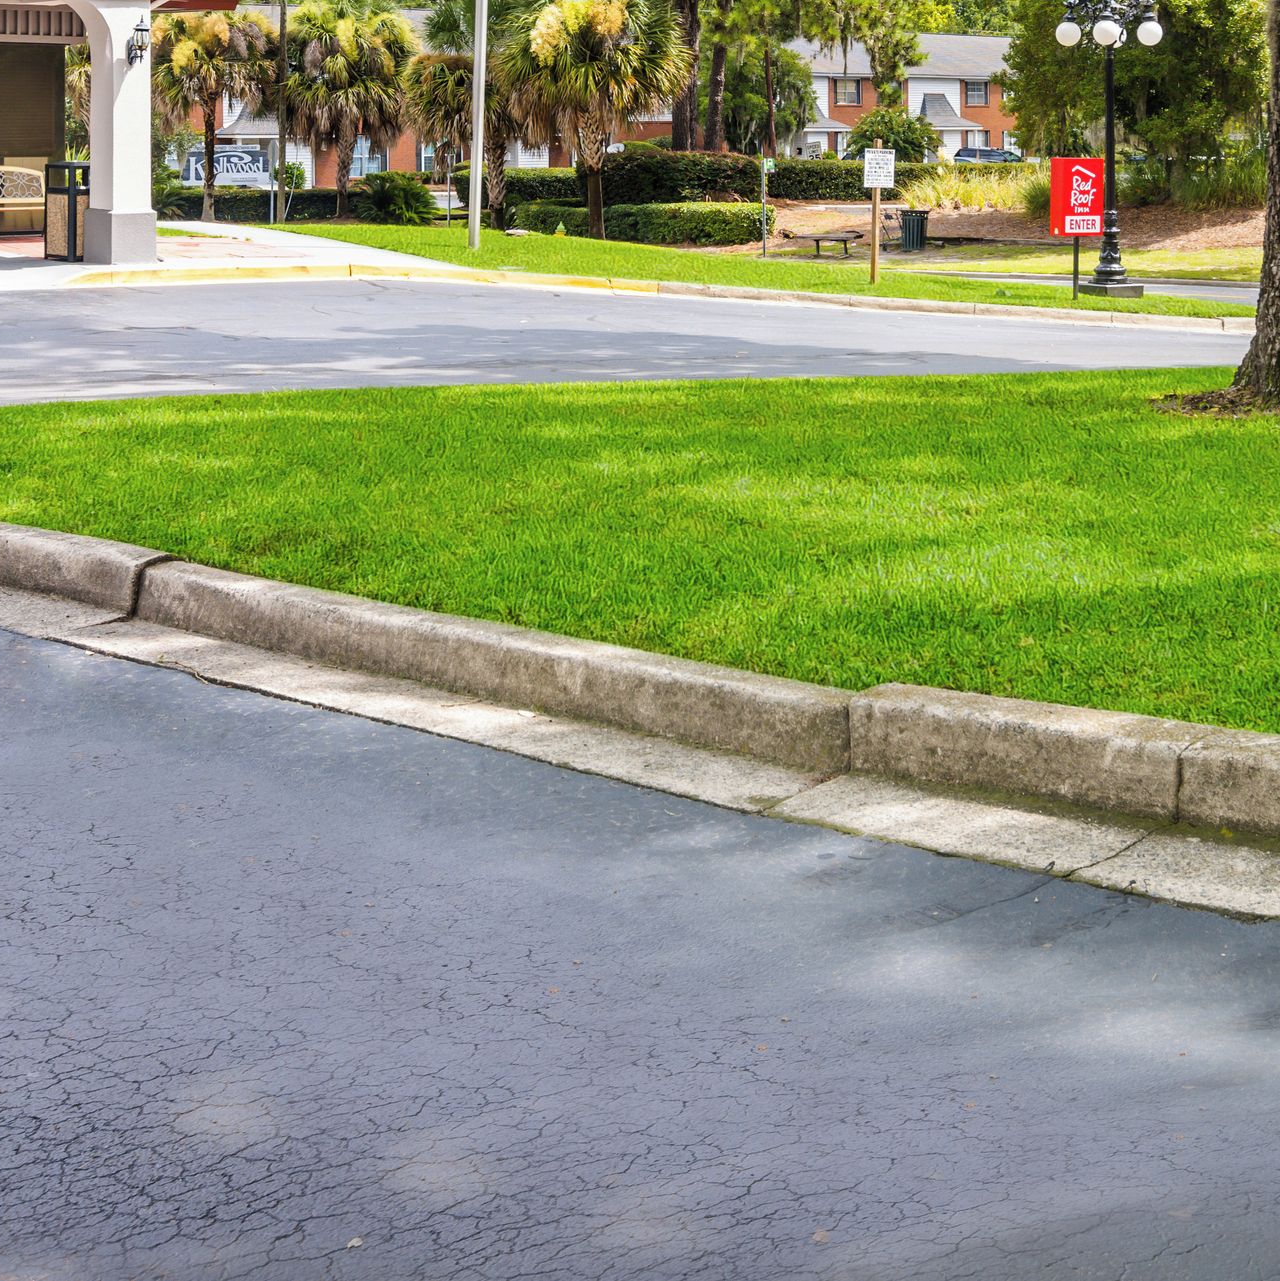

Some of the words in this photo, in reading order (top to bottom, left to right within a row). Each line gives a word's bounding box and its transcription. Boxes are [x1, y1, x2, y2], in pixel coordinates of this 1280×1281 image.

[188, 152, 264, 181] Kollwood
[1073, 176, 1092, 190] Red
[1070, 189, 1096, 207] Roof
[1070, 219, 1096, 230] ENTER
